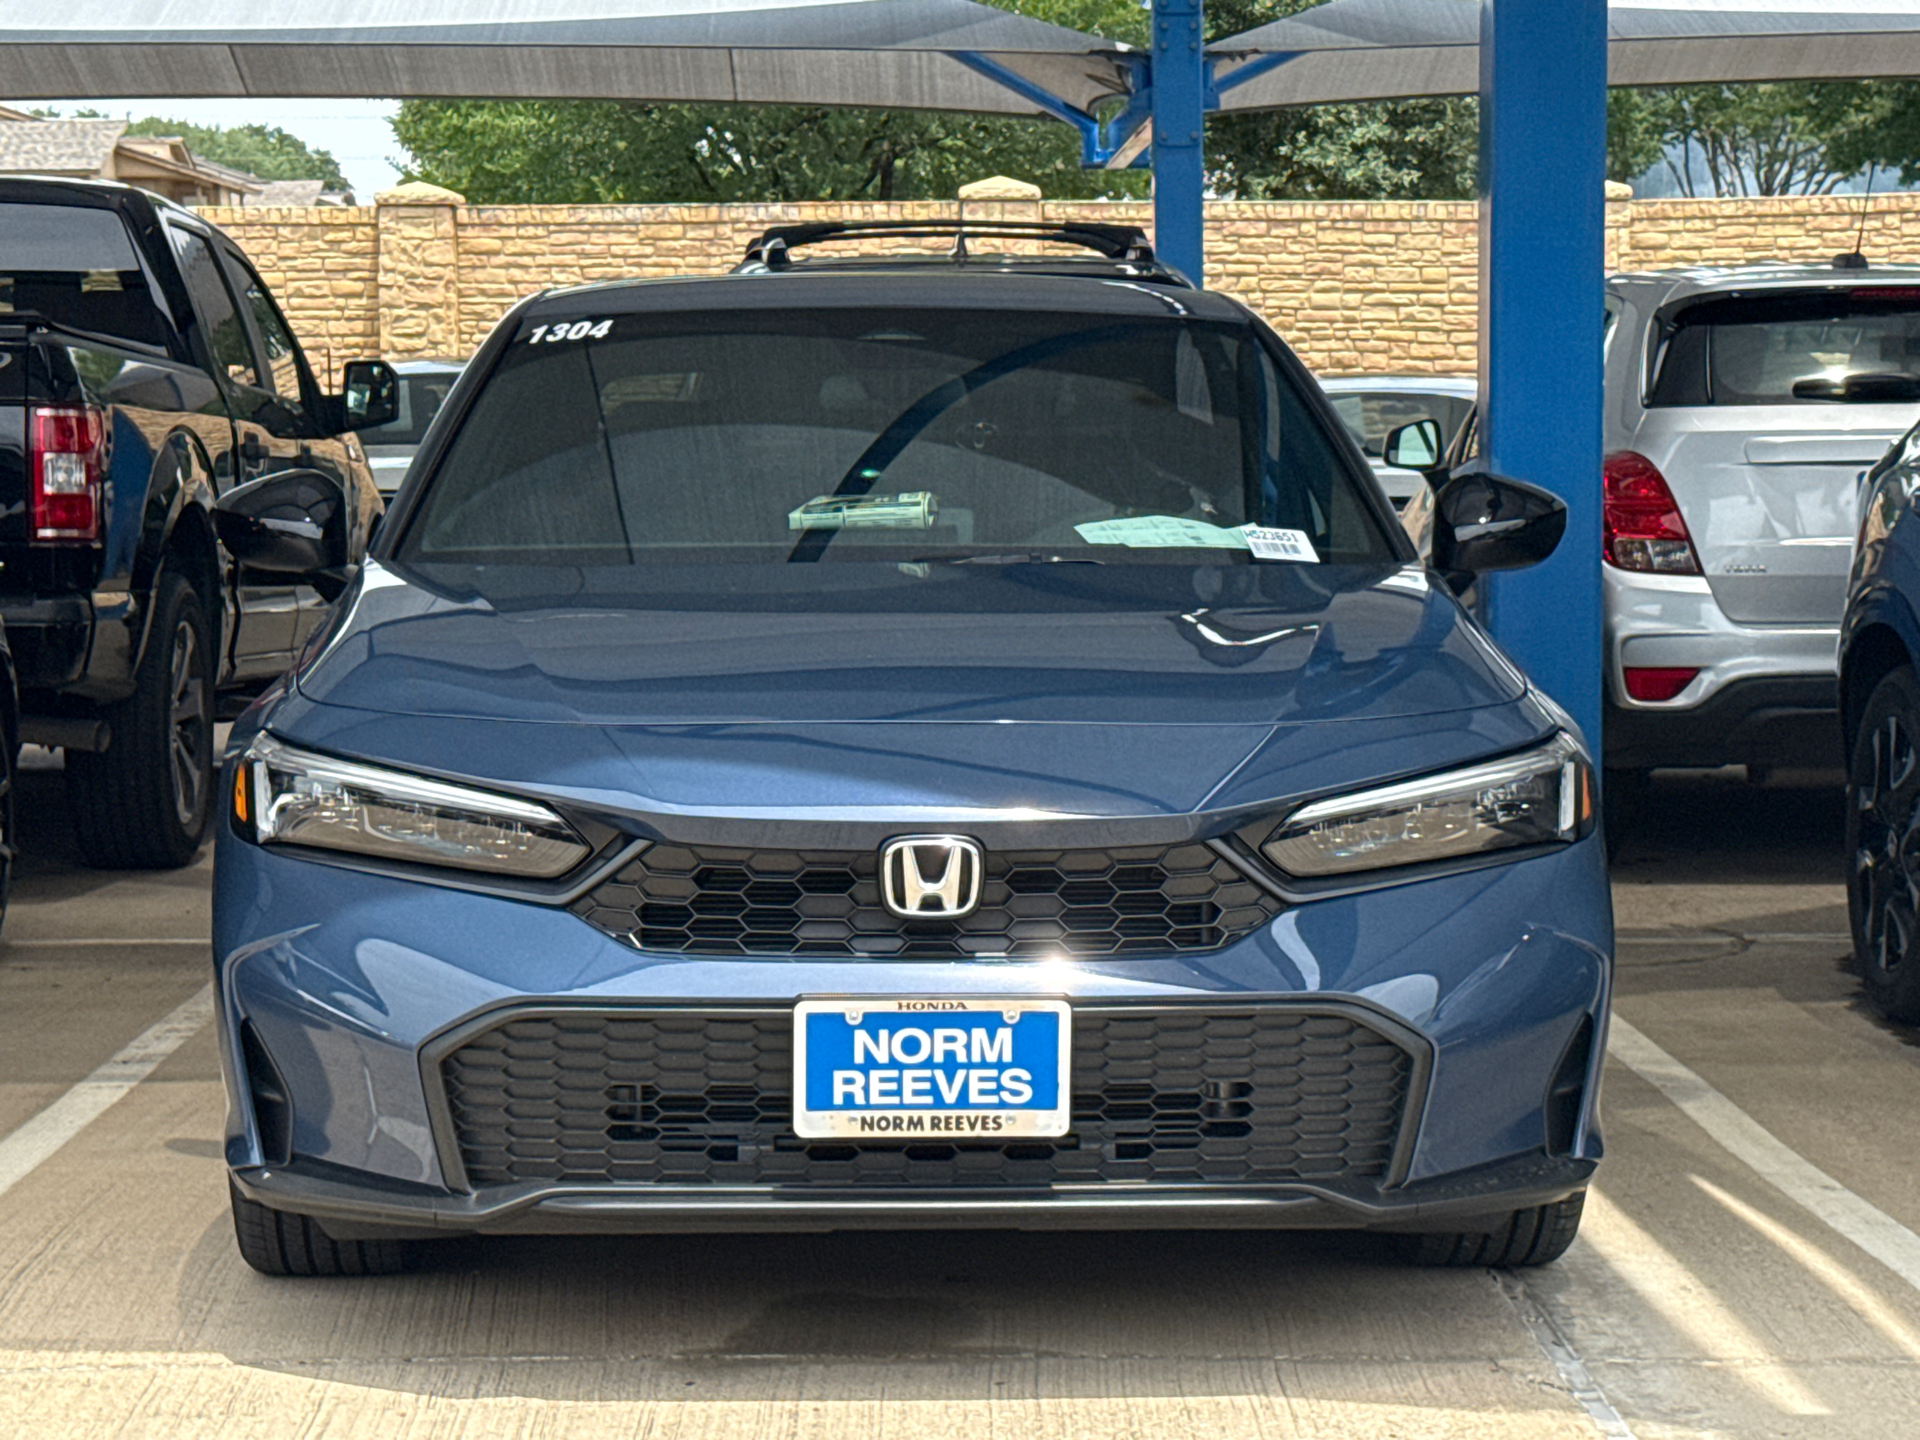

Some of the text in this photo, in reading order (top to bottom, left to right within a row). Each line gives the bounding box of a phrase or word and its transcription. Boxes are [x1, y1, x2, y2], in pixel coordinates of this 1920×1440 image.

[528, 319, 614, 344] 1304
[897, 1001, 968, 1011] HONDA
[853, 1027, 1013, 1064] NORM
[832, 1068, 1033, 1105] REEVES
[860, 1115, 1003, 1132] NORM REEVES
